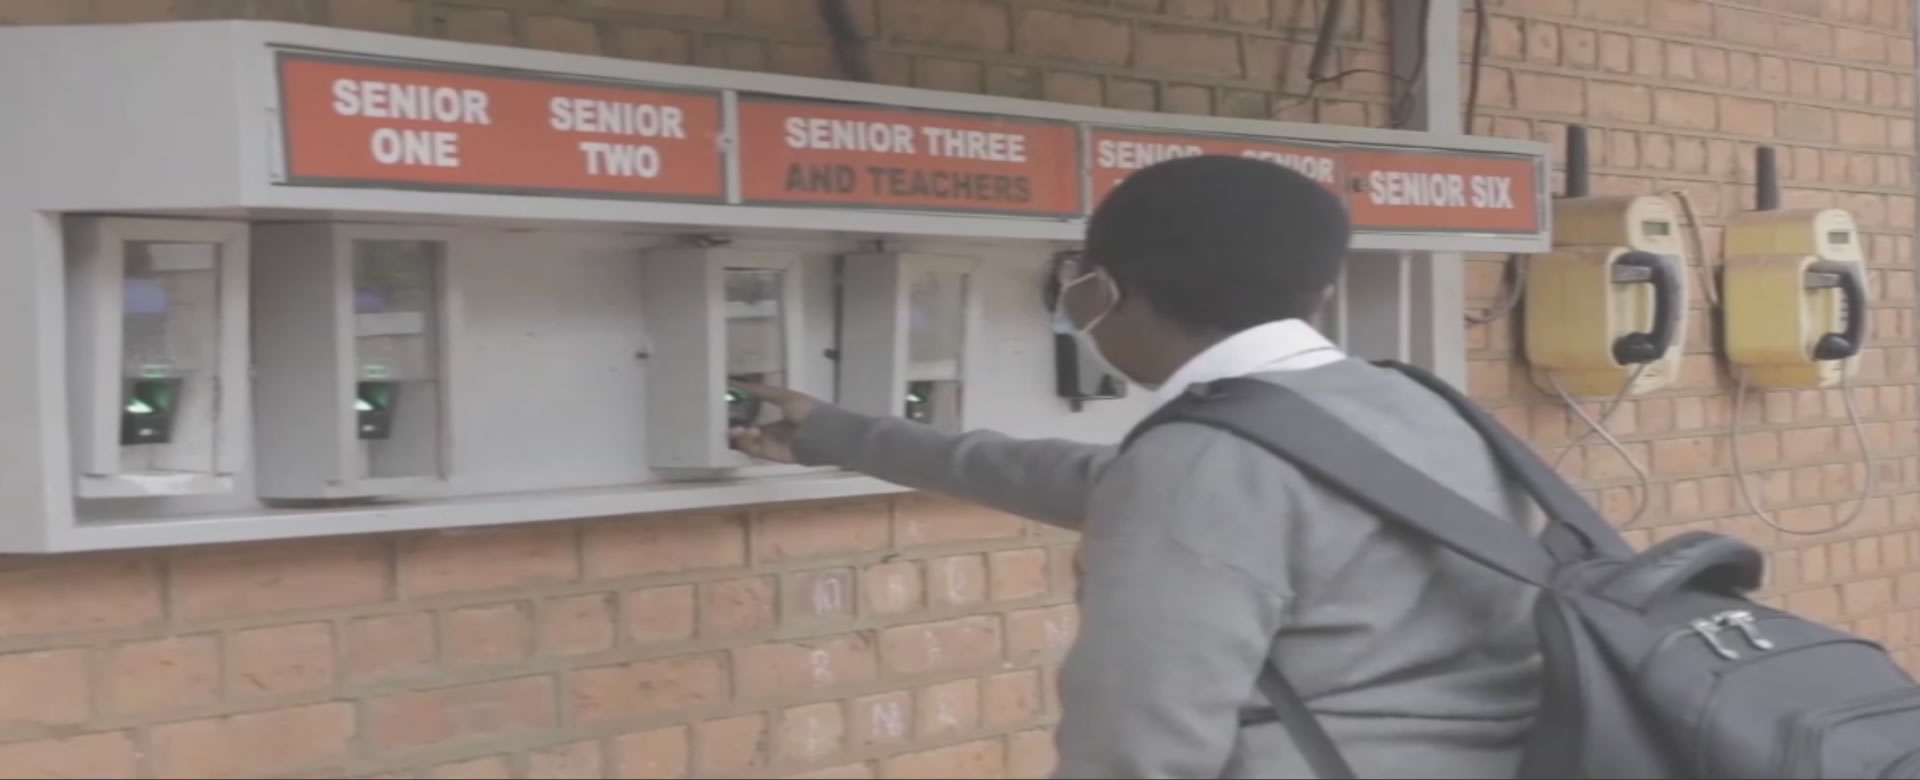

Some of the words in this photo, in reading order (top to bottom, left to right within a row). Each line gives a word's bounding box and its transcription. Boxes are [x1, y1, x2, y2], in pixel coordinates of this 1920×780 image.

[332, 79, 491, 125] SENIOR
[549, 97, 685, 139] SENIOR
[371, 128, 460, 168] ONE
[579, 142, 660, 178] TWO
[785, 117, 915, 154] SENIOR
[921, 126, 1026, 163] THREE
[785, 163, 855, 194] AND
[867, 166, 1032, 203] TEACHERS
[1369, 170, 1466, 208] SENIOR
[1471, 175, 1514, 209] SIX
